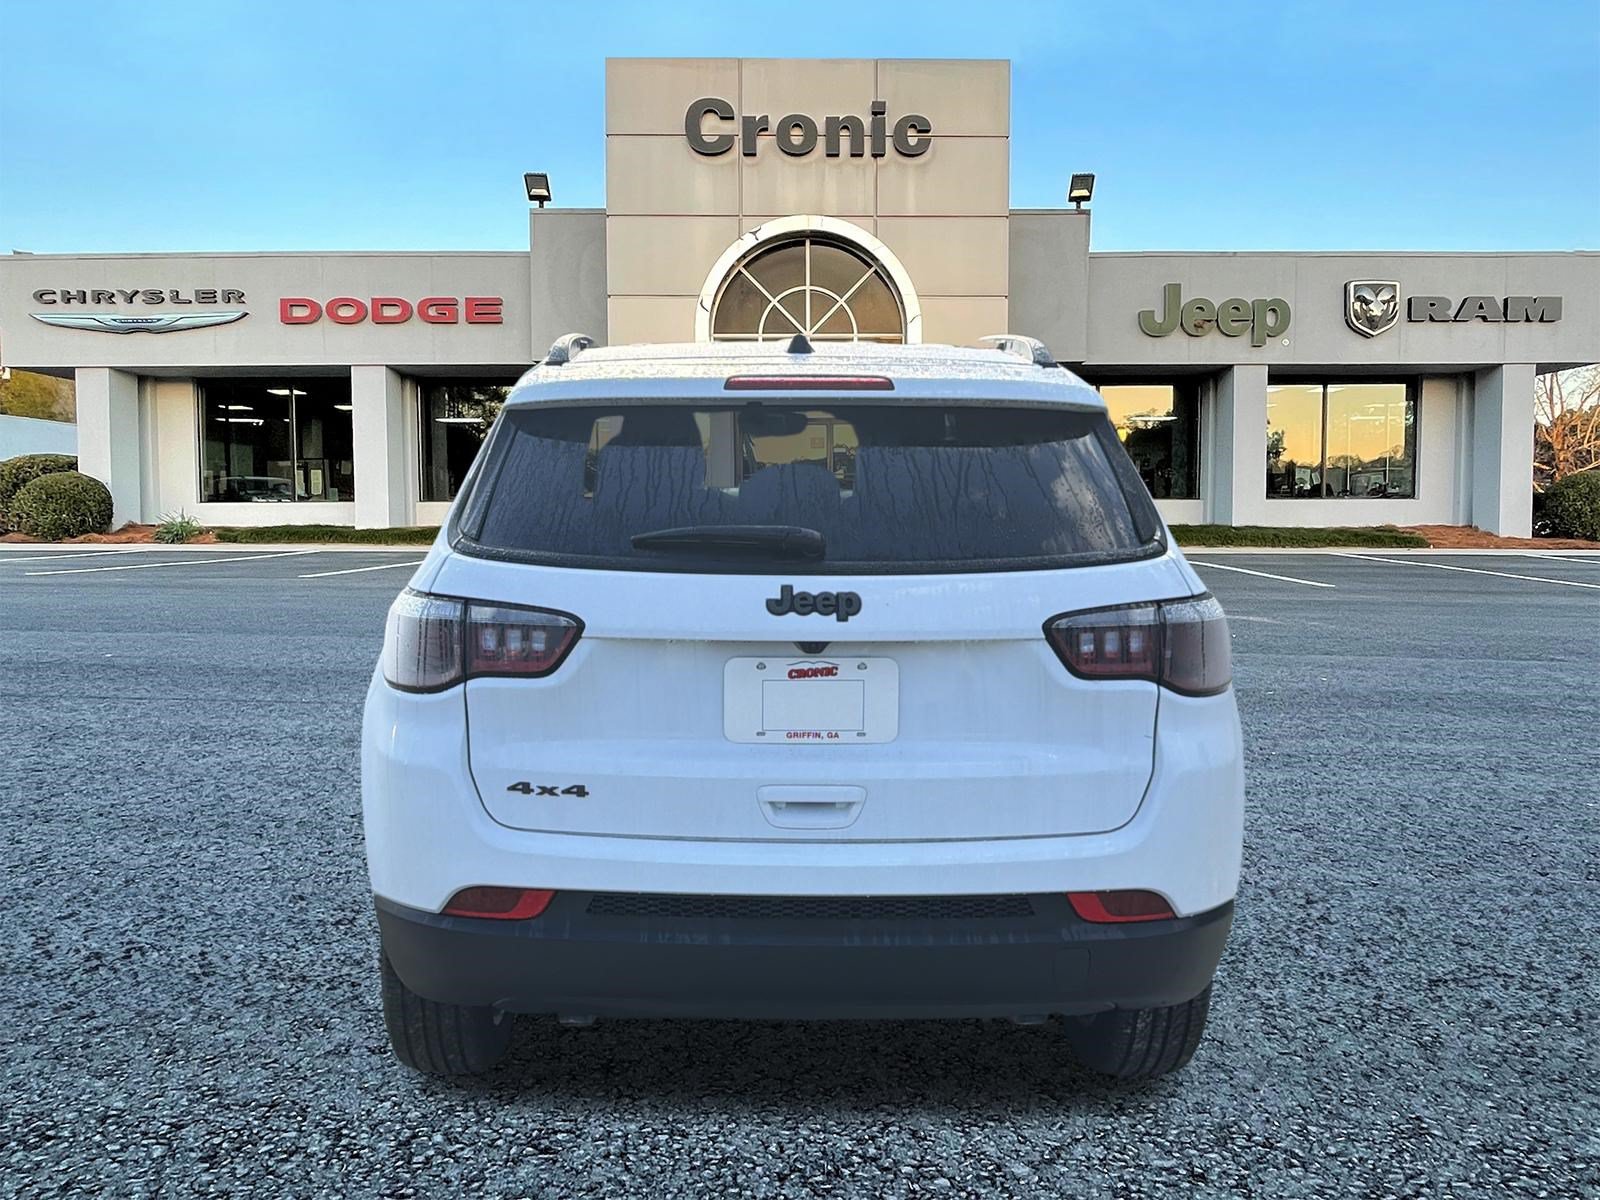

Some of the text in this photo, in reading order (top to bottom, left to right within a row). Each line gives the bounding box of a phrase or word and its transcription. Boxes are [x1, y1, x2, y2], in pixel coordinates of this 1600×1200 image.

[685, 97, 932, 157] Cronic
[32, 288, 246, 305] CHRYSLER
[1408, 296, 1563, 322] RAM
[279, 296, 504, 325] DODGE
[1138, 283, 1291, 347] Jeep
[766, 584, 862, 622] Jeep
[788, 666, 839, 679] CRONIC
[786, 731, 840, 740] GRIFFIN, GA
[507, 781, 590, 798] 4x4
